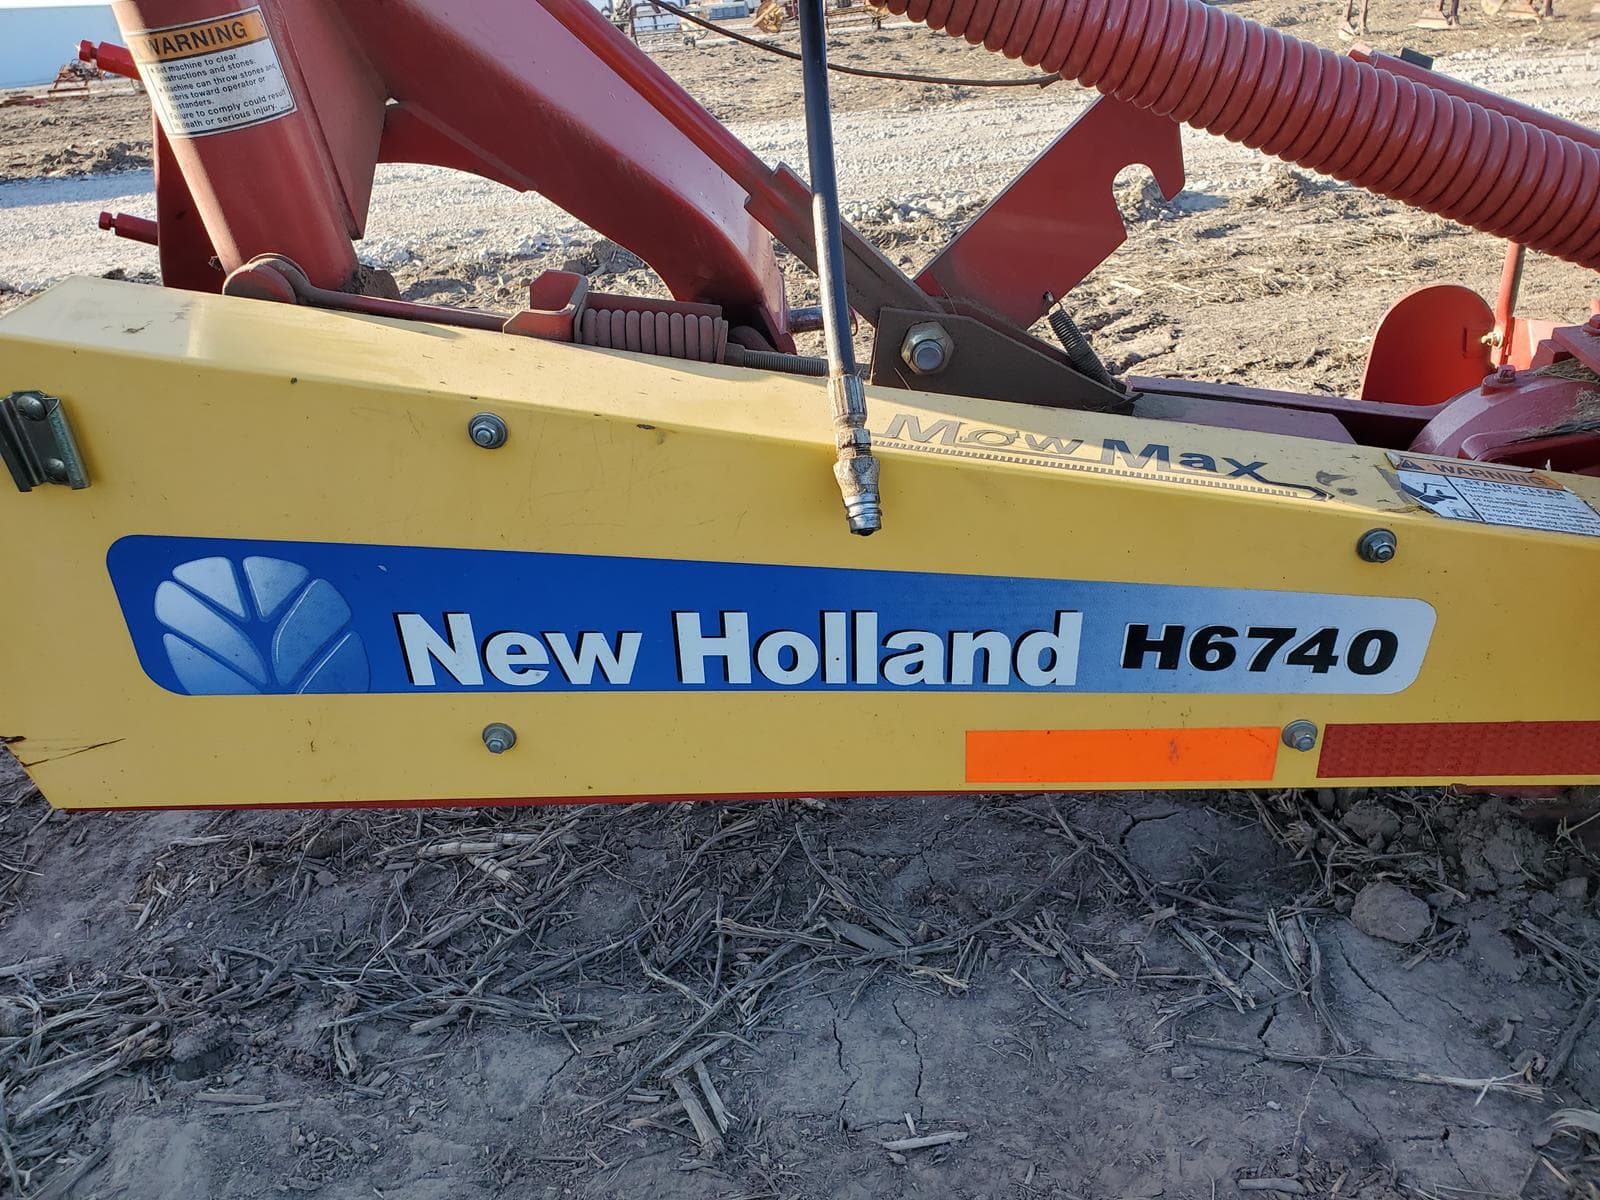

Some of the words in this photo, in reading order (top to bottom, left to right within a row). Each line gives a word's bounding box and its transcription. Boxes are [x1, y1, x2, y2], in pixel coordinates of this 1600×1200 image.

[144, 21, 247, 56] WARNING
[168, 61, 202, 72] machine
[216, 53, 237, 63] clear
[160, 70, 208, 83] structions
[209, 65, 226, 75] and
[196, 79, 212, 88] can
[213, 73, 238, 85] throw
[240, 66, 265, 79] stones
[190, 87, 220, 98] toward
[222, 79, 257, 94] operator
[208, 102, 241, 116] comply
[243, 96, 267, 107] could
[217, 111, 251, 124] serious
[884, 413, 1084, 455] Mow
[1101, 438, 1267, 482] Max
[1432, 463, 1547, 485] WARNING
[392, 611, 643, 686] New
[671, 610, 1084, 686] Holland
[1120, 623, 1399, 675] H6740
